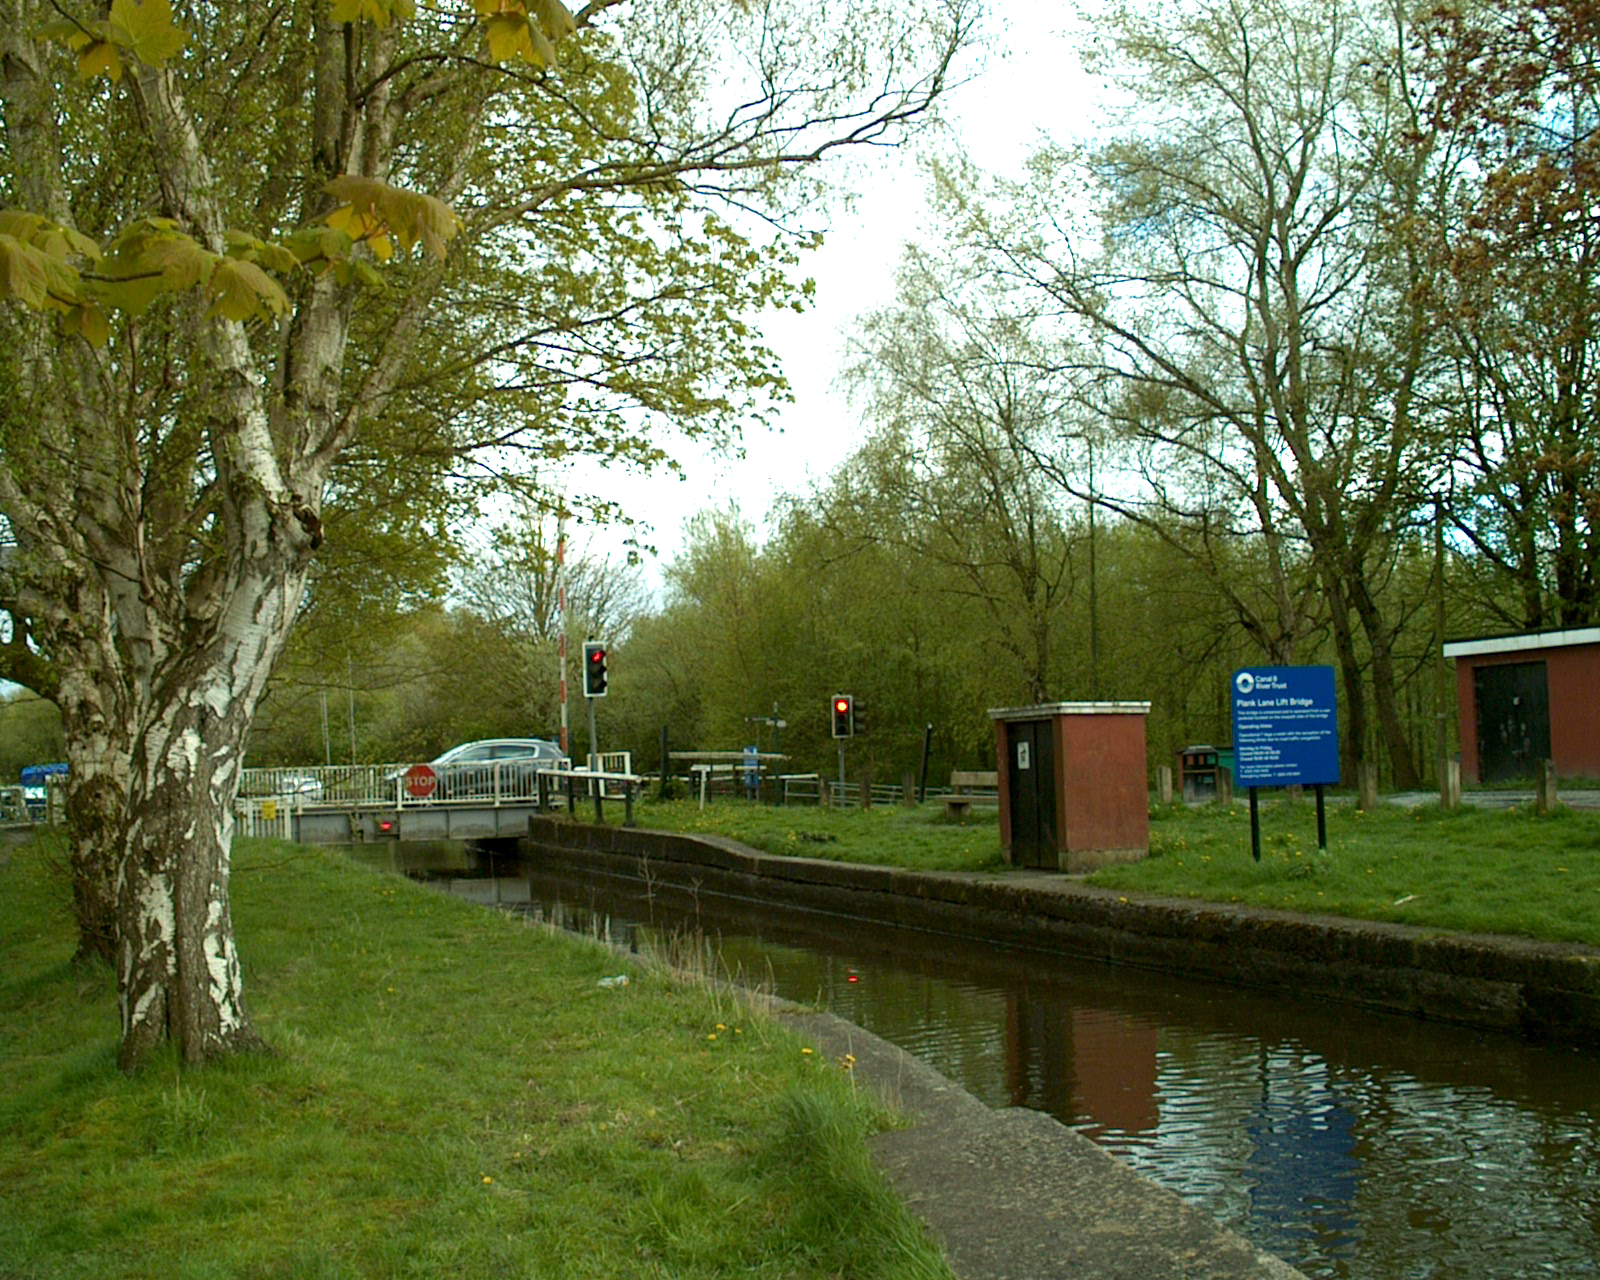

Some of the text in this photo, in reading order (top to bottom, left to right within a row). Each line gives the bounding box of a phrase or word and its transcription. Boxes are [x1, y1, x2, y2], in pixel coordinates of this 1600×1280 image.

[1255, 675, 1272, 683] Canal
[1237, 697, 1313, 707] Plank Lane Lift Bridge
[405, 775, 436, 787] STOP
